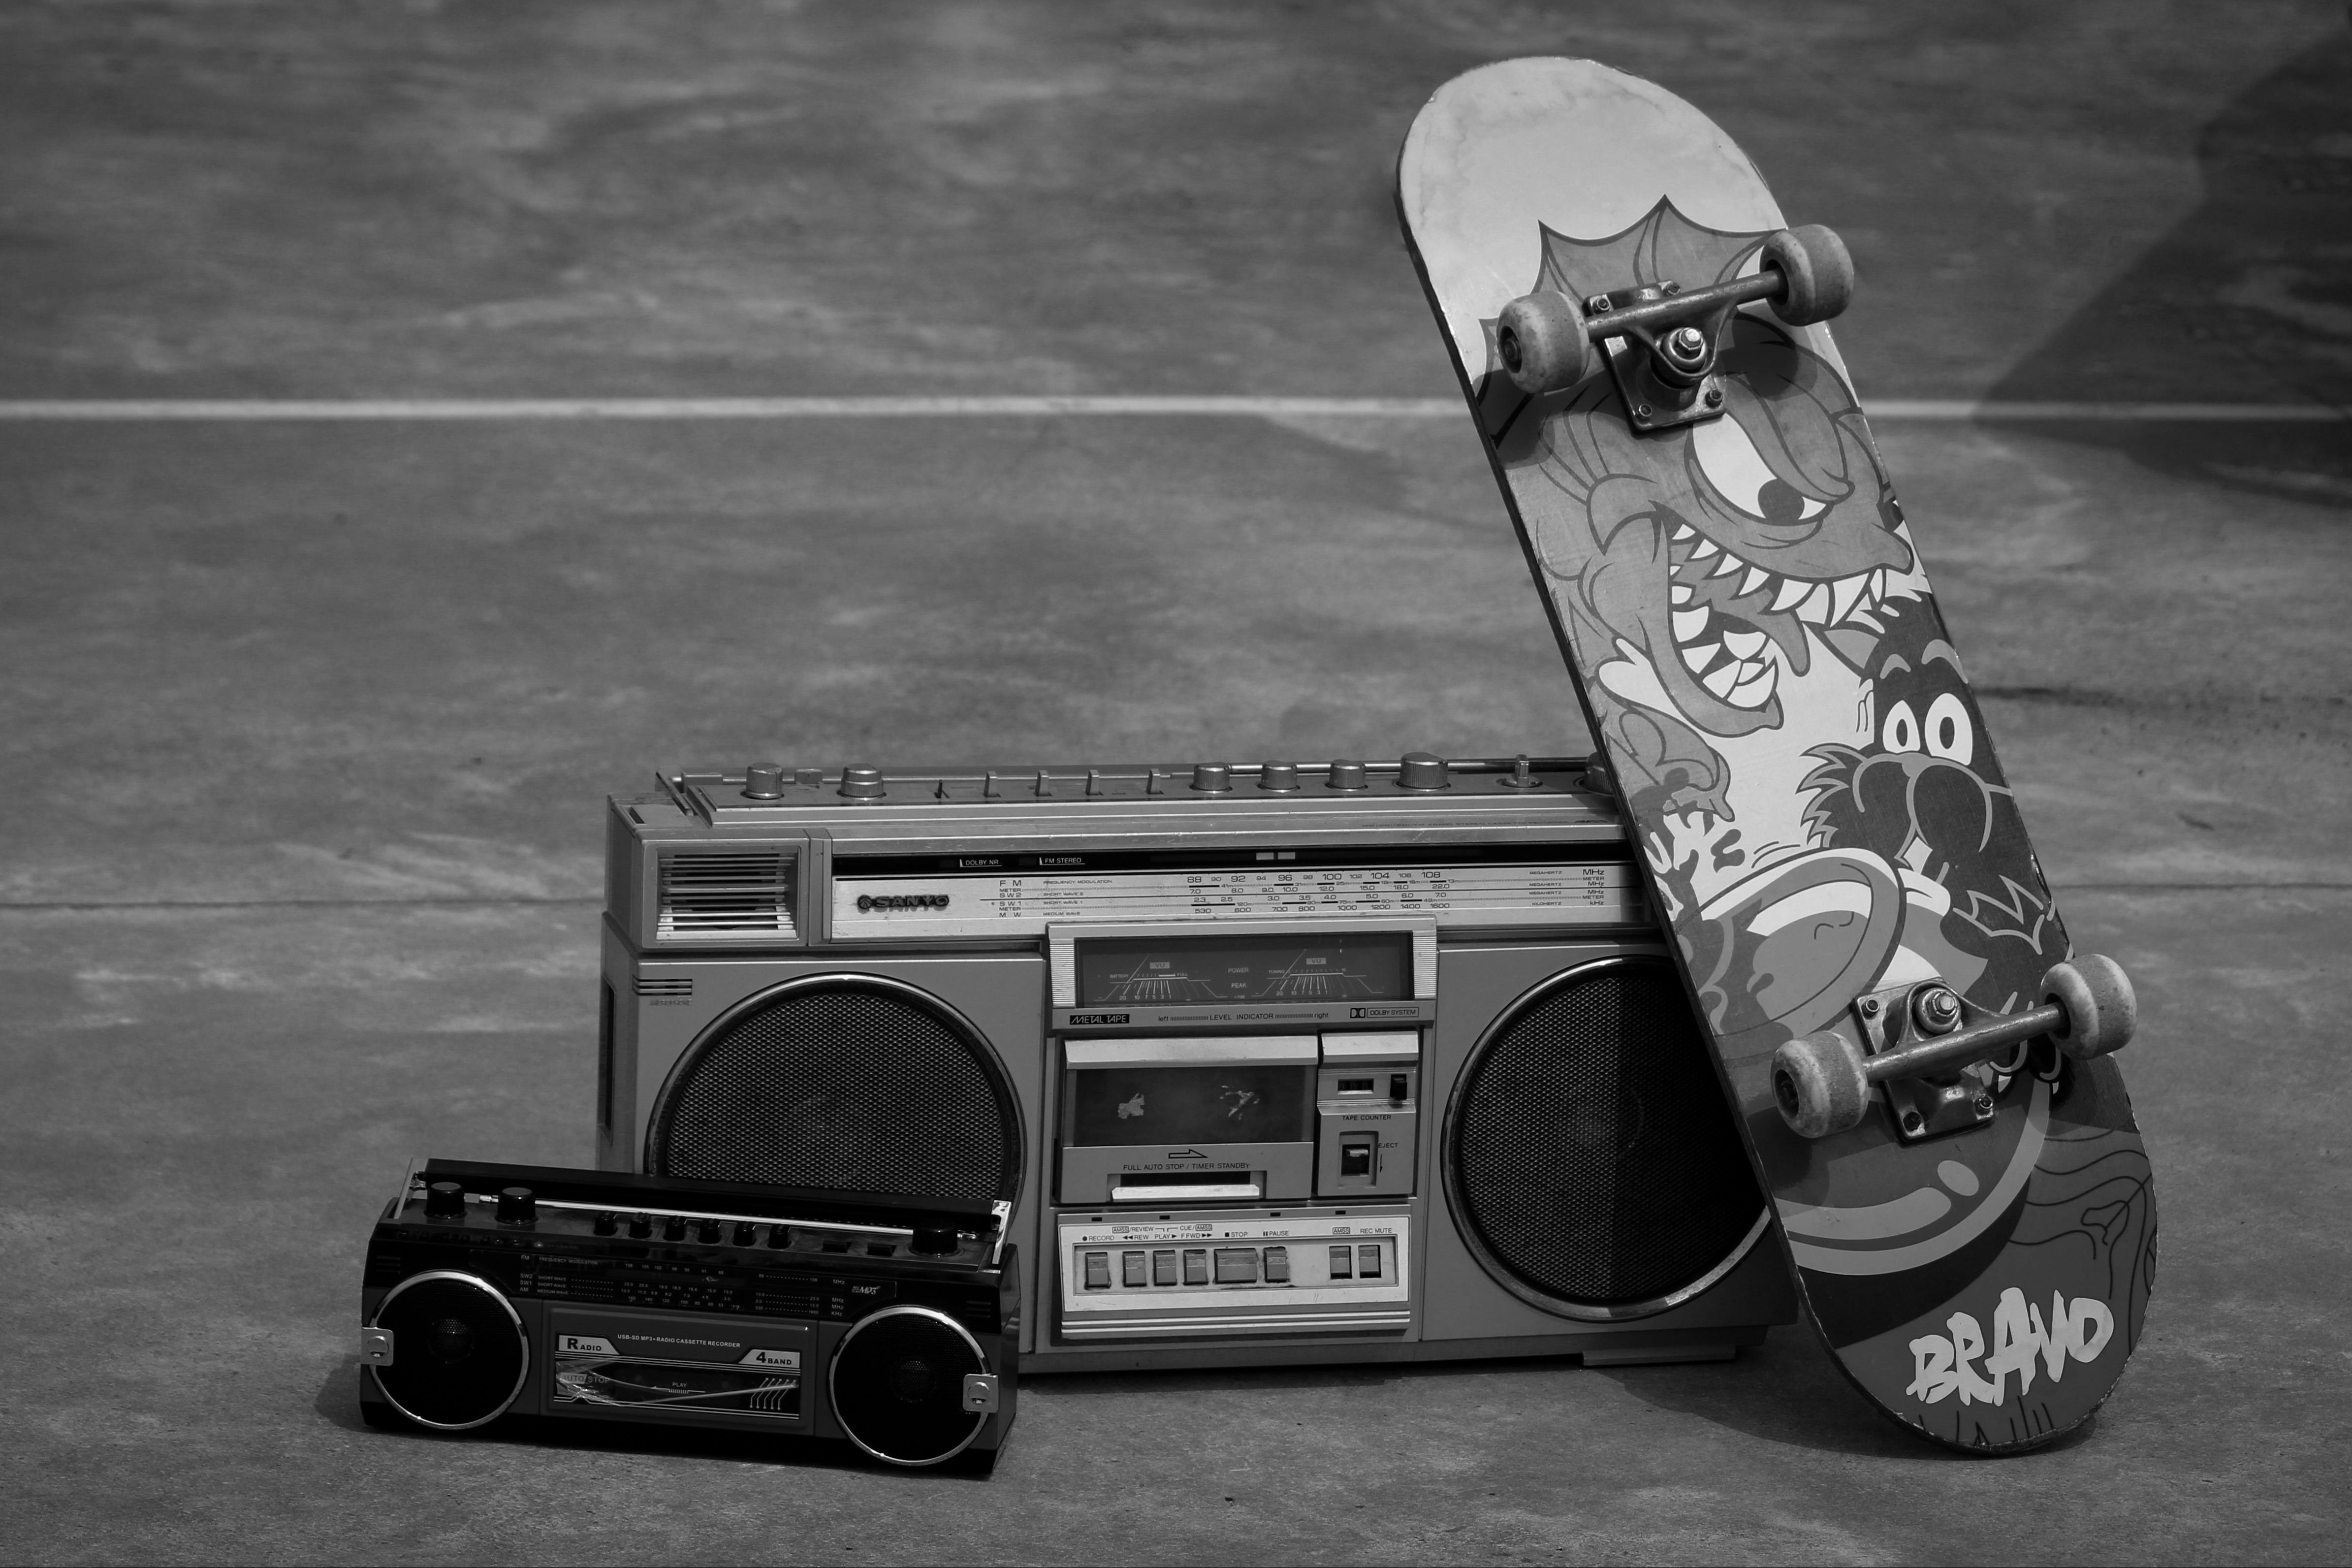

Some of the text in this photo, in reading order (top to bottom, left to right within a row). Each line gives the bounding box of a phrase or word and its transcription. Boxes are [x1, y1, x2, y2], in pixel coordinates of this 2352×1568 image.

[875, 895, 949, 907] SANYO
[1071, 1015, 1126, 1024] METAL TAPE
[859, 1286, 876, 1295] MP3
[1906, 1287, 2114, 1407] BRAVO
